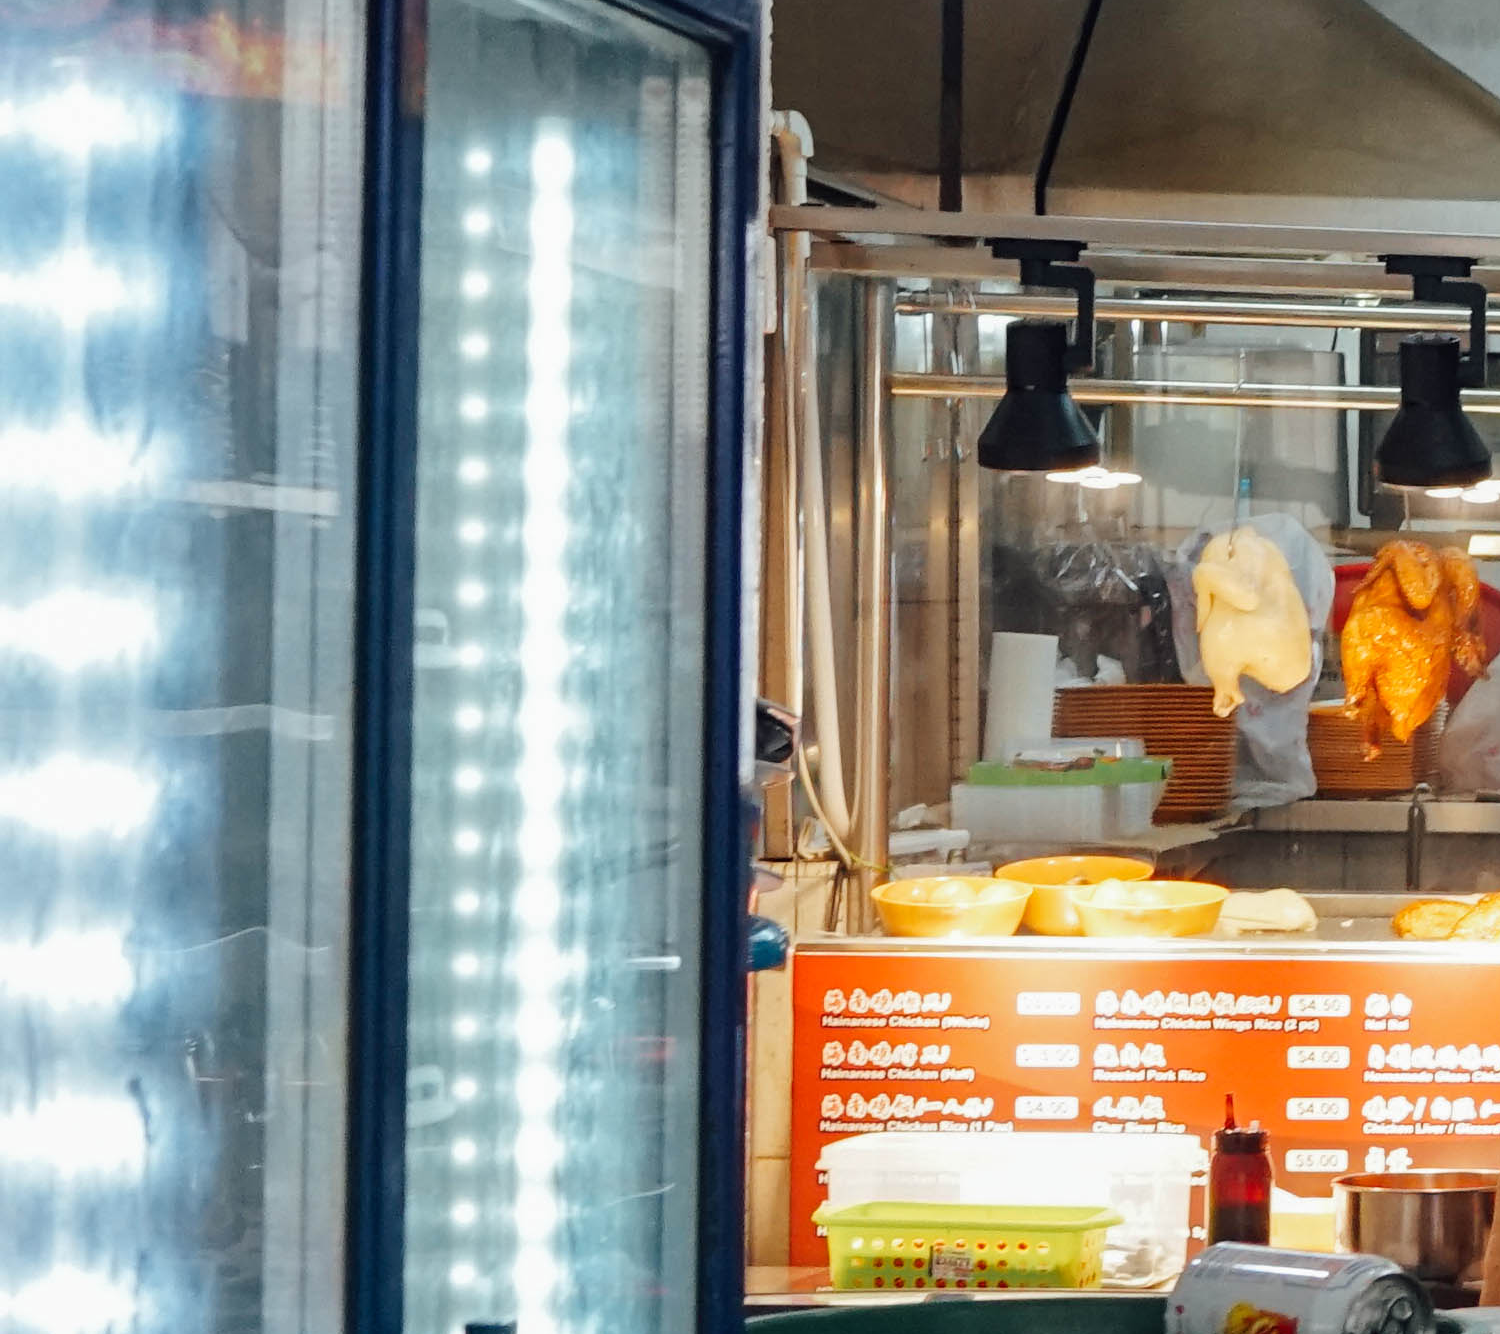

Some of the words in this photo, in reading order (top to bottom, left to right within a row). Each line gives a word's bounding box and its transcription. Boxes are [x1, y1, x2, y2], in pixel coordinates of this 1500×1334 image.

[821, 1016, 887, 1028] Hainanese
[889, 1017, 940, 1028] Chicken
[1094, 1018, 1159, 1030] Hainanese
[1161, 1019, 1211, 1031] Chicken
[1213, 1019, 1252, 1032] Wings
[1254, 1019, 1283, 1031] Rice
[820, 1068, 886, 1080] Hainanese
[888, 1069, 939, 1080] Chicken
[1146, 1070, 1176, 1082] Pork
[1178, 1071, 1207, 1083] Rice
[820, 1121, 885, 1132] Hainanese
[886, 1121, 937, 1132] Chicken
[939, 1121, 967, 1132] Rice
